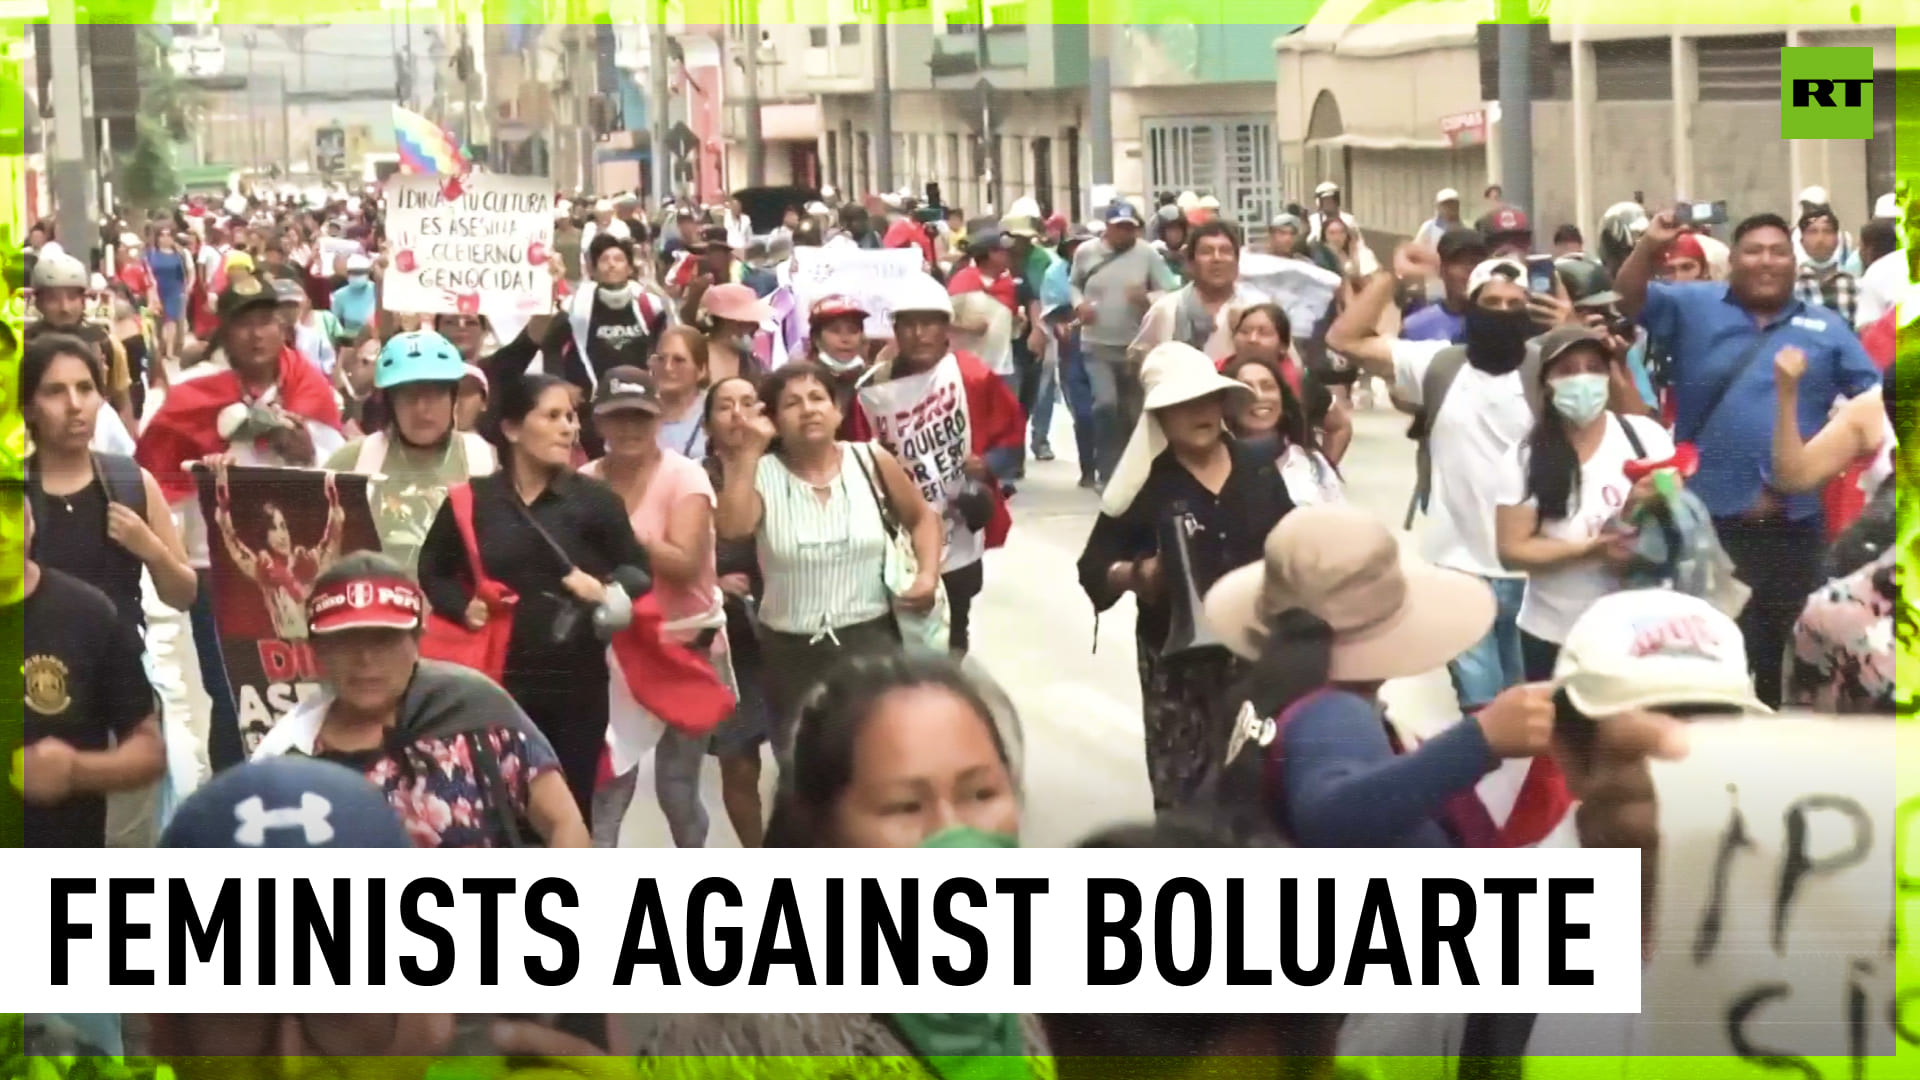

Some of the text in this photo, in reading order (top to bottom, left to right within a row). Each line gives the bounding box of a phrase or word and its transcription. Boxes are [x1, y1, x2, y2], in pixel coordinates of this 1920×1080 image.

[483, 190, 549, 214] CULTURA
[420, 217, 442, 236] ES
[418, 268, 535, 292] GENOCIDA!
[904, 408, 966, 462] QUIERO
